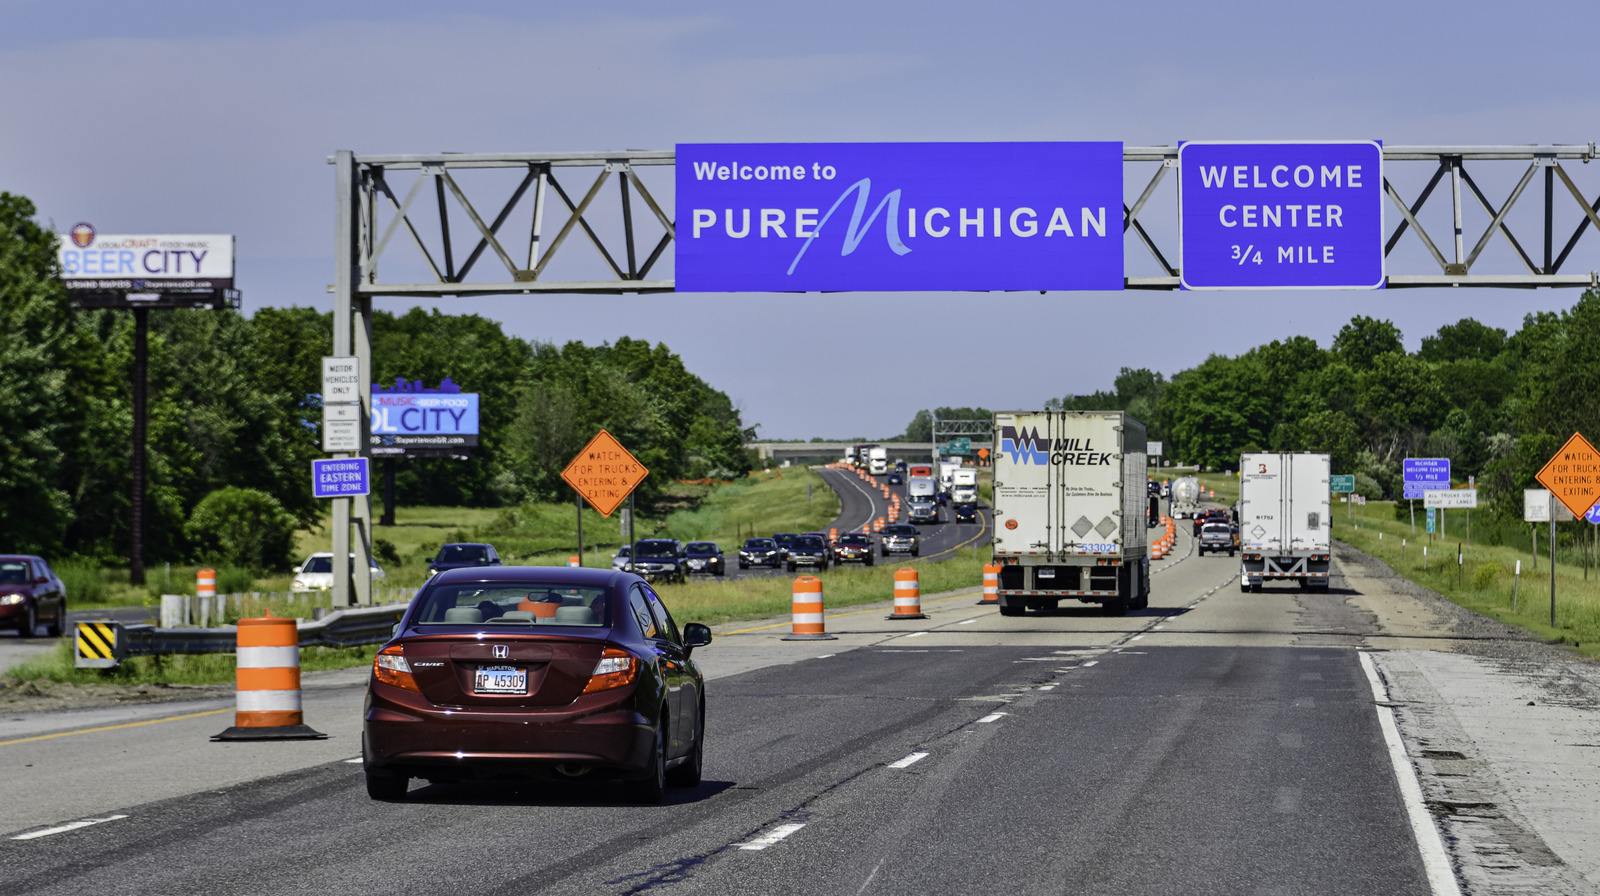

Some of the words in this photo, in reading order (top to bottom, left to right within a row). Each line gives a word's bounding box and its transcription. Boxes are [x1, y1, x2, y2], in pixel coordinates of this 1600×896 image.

[693, 161, 806, 181] Welcome
[812, 162, 837, 181] to
[1199, 165, 1363, 188] WELCOME
[1219, 204, 1343, 228] CENTER
[692, 208, 820, 239] PURE
[1278, 246, 1335, 264] MILE
[63, 250, 136, 274] BEER
[143, 250, 208, 273] CITY
[329, 365, 353, 373] MOTOR
[326, 376, 359, 384] VEHICLES
[379, 396, 417, 406] MUSIC
[442, 399, 469, 407] FOOD
[401, 407, 467, 432] CITY
[1053, 438, 1094, 451] MILL
[589, 451, 620, 460] WATCH
[1051, 452, 1112, 466] CREEK
[1564, 453, 1593, 461] WATCH
[321, 462, 360, 472] ENTERING
[574, 465, 593, 475] FOR
[599, 464, 638, 473] TRUCKS
[1552, 465, 1569, 473] FOR
[320, 472, 362, 483] EASTERN
[578, 477, 618, 486] ENTERING
[621, 477, 628, 486] &
[1553, 475, 1592, 484] ENTERING
[321, 484, 340, 492] TIME
[341, 482, 362, 491] ZONE
[1563, 487, 1594, 496] EXITING
[589, 490, 620, 498] EXITING
[1081, 543, 1117, 552] 533021
[476, 674, 489, 688] AP
[494, 674, 525, 688] 45309
